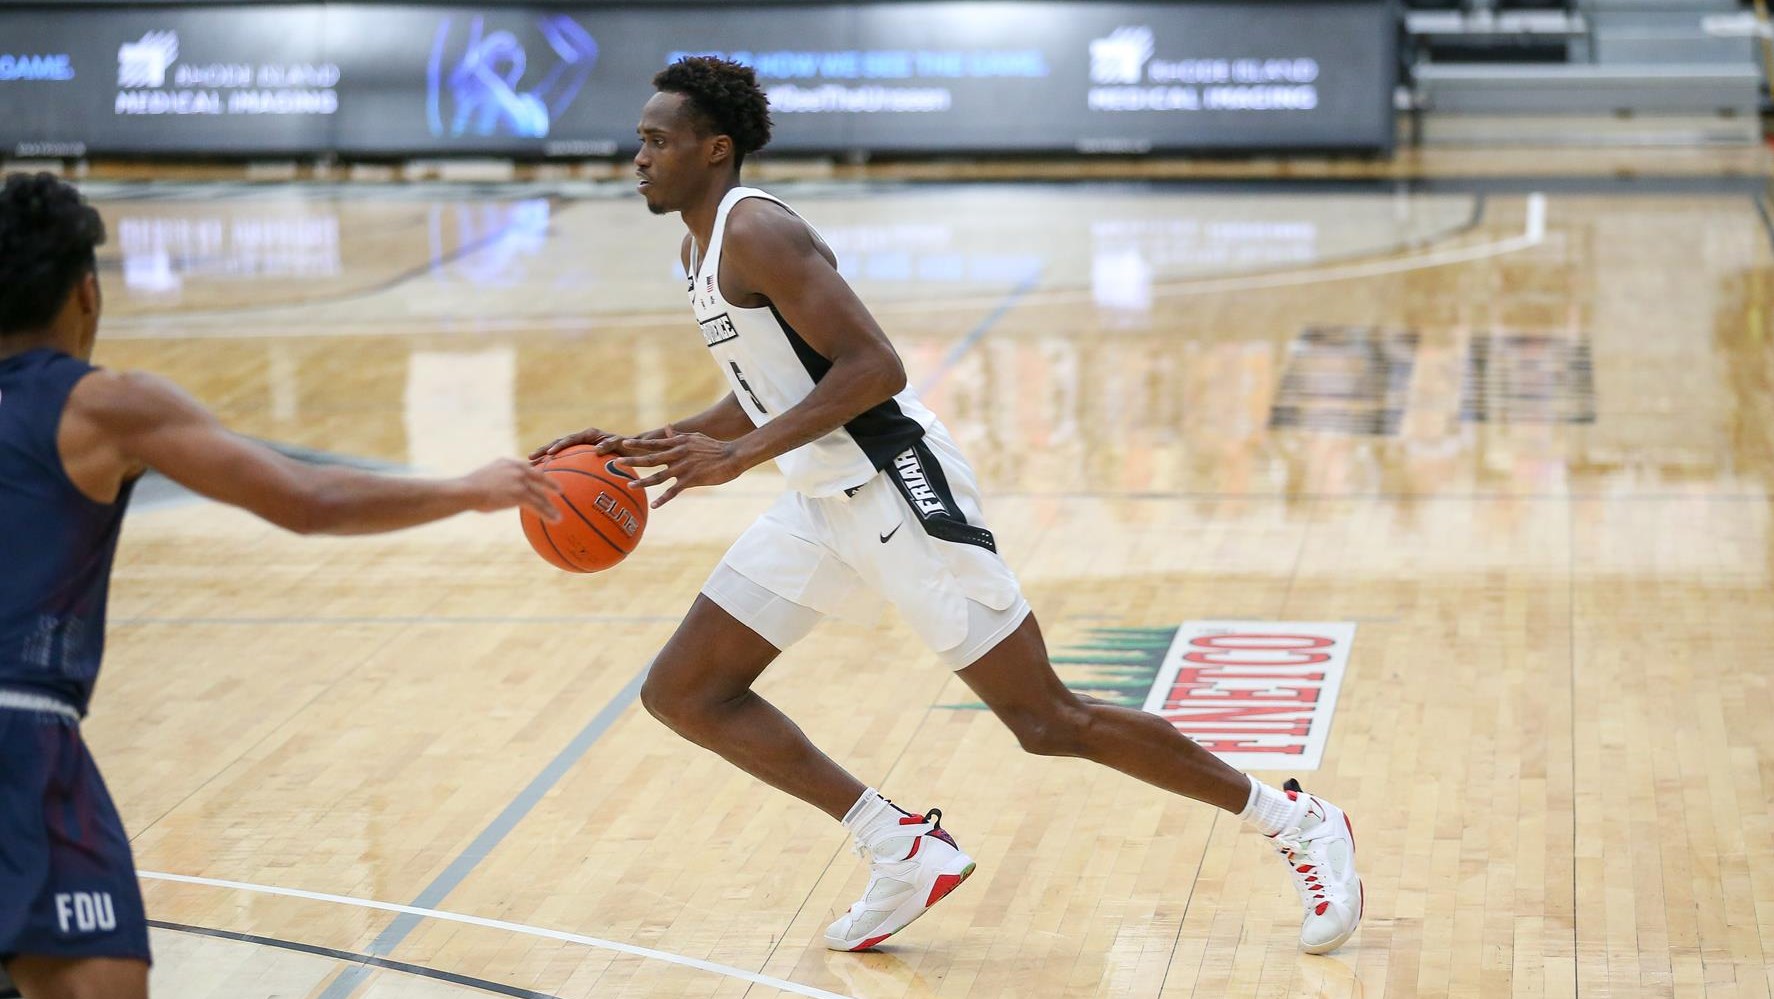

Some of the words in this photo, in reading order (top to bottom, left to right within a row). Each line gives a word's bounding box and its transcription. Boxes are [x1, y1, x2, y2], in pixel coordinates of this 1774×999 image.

[1088, 85, 1199, 110] MEDICAL
[1203, 85, 1319, 110] IMAGING
[55, 892, 117, 934] FDU
